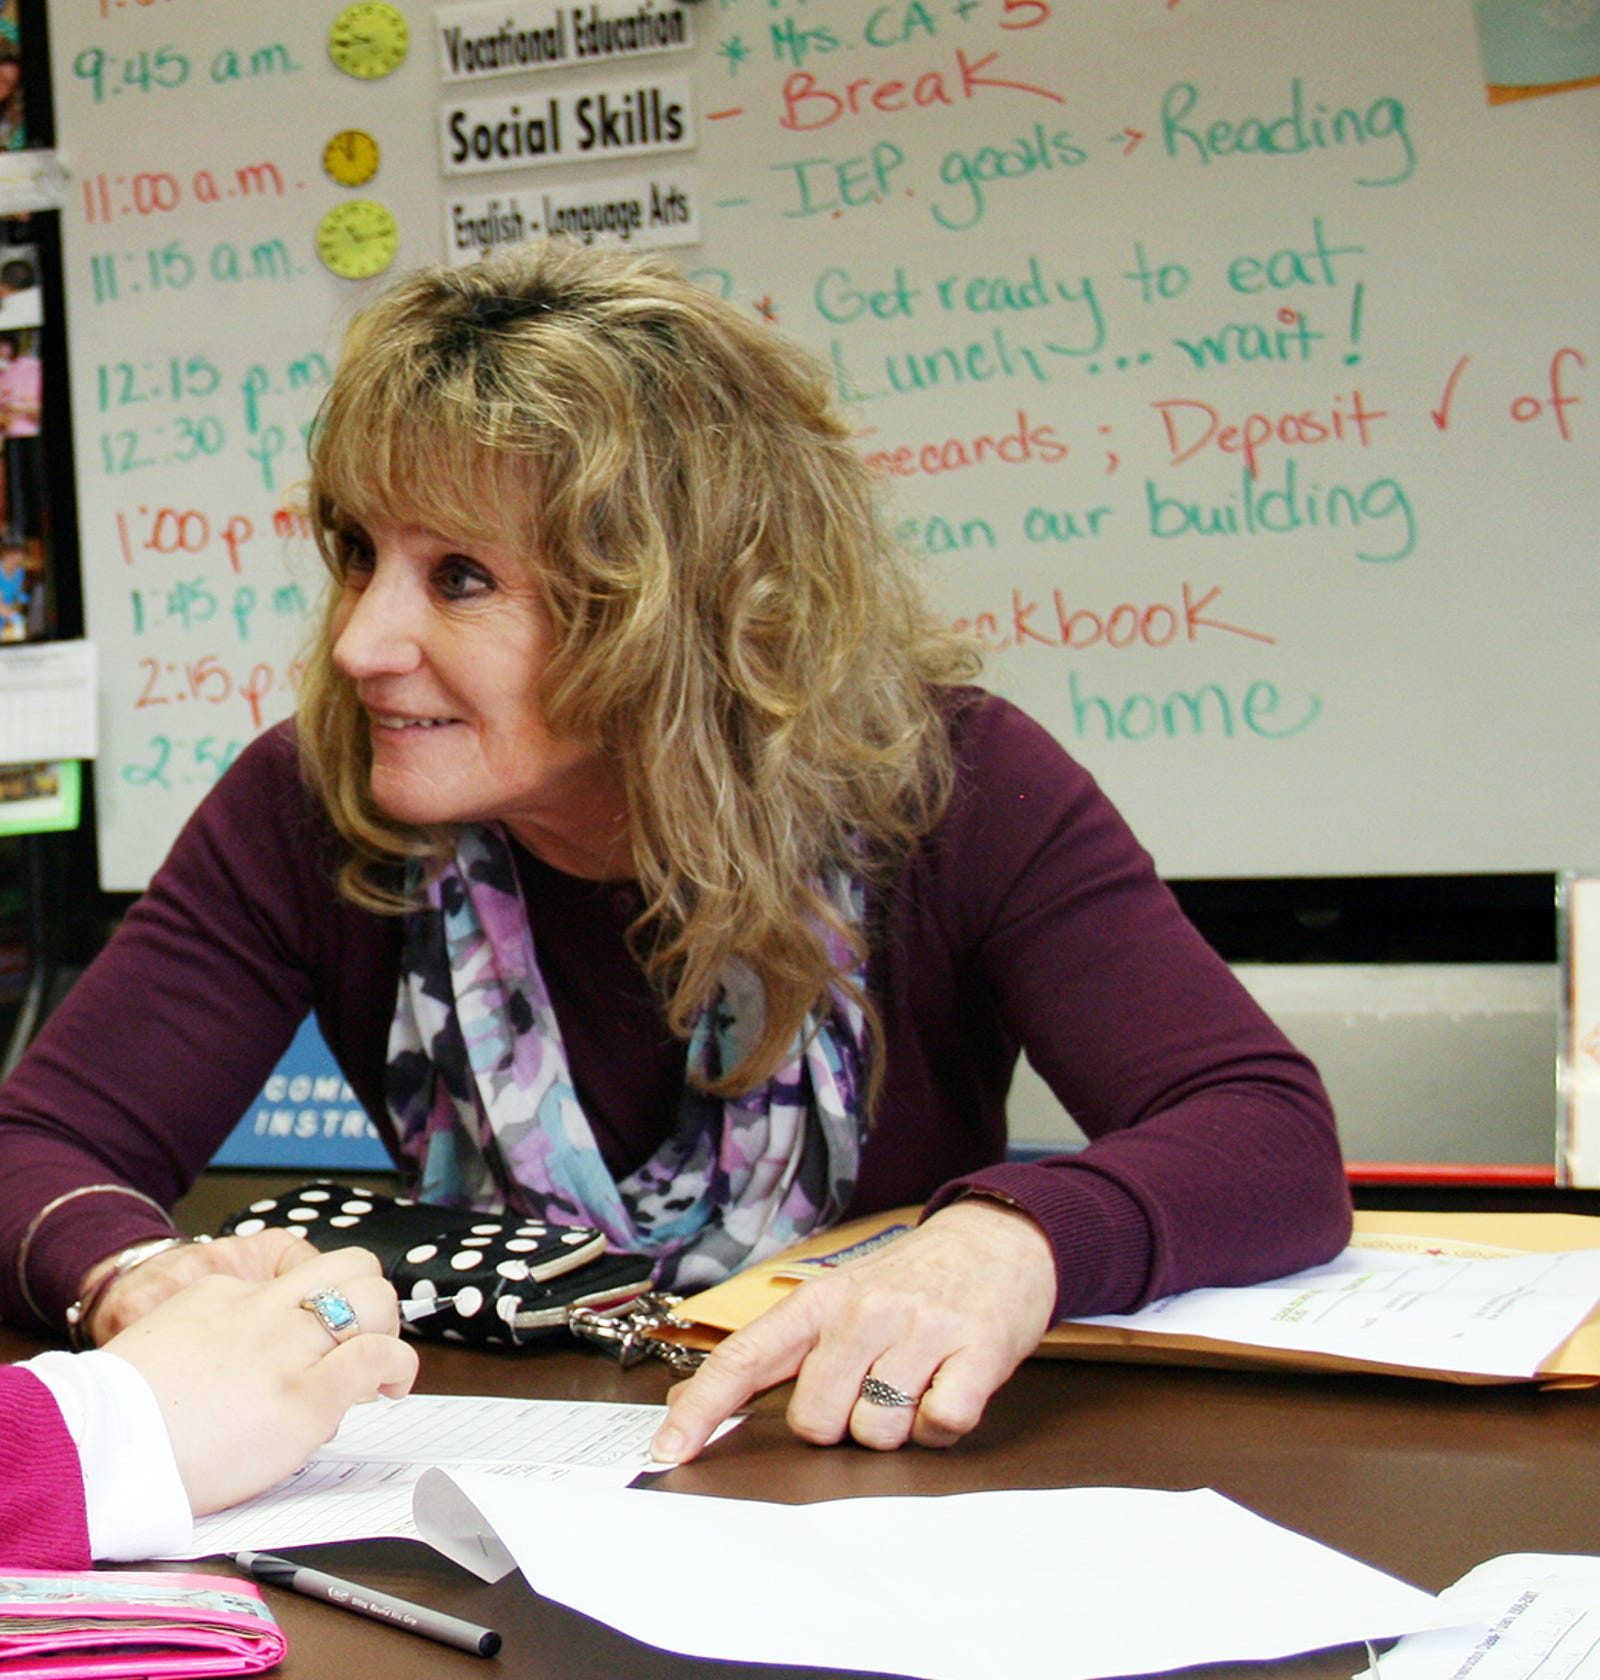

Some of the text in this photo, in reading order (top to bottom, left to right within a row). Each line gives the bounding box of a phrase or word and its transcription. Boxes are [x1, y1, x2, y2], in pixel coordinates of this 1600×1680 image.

[73, 45, 191, 103] 9:45
[443, 2, 687, 75] Vocational Education
[450, 88, 684, 164] Social Skills
[779, 48, 1067, 131] Break
[931, 123, 1090, 232] goals
[1160, 77, 1417, 188] Reading
[83, 172, 181, 225] 11:00
[453, 197, 525, 259] English
[543, 194, 642, 246] Language
[650, 183, 689, 225] Arts
[90, 241, 196, 304] 11:15
[815, 267, 923, 324] Get
[937, 256, 1106, 357] ready
[1123, 240, 1191, 304] to
[1226, 216, 1366, 295] eat
[97, 355, 221, 412] 12:15
[1150, 390, 1388, 481] Deposit
[1509, 347, 1586, 442] of
[116, 506, 211, 566] 1:00
[1024, 505, 1113, 543] our
[1144, 458, 1418, 564] building
[133, 654, 232, 709] 2:15
[1067, 671, 1322, 741] home
